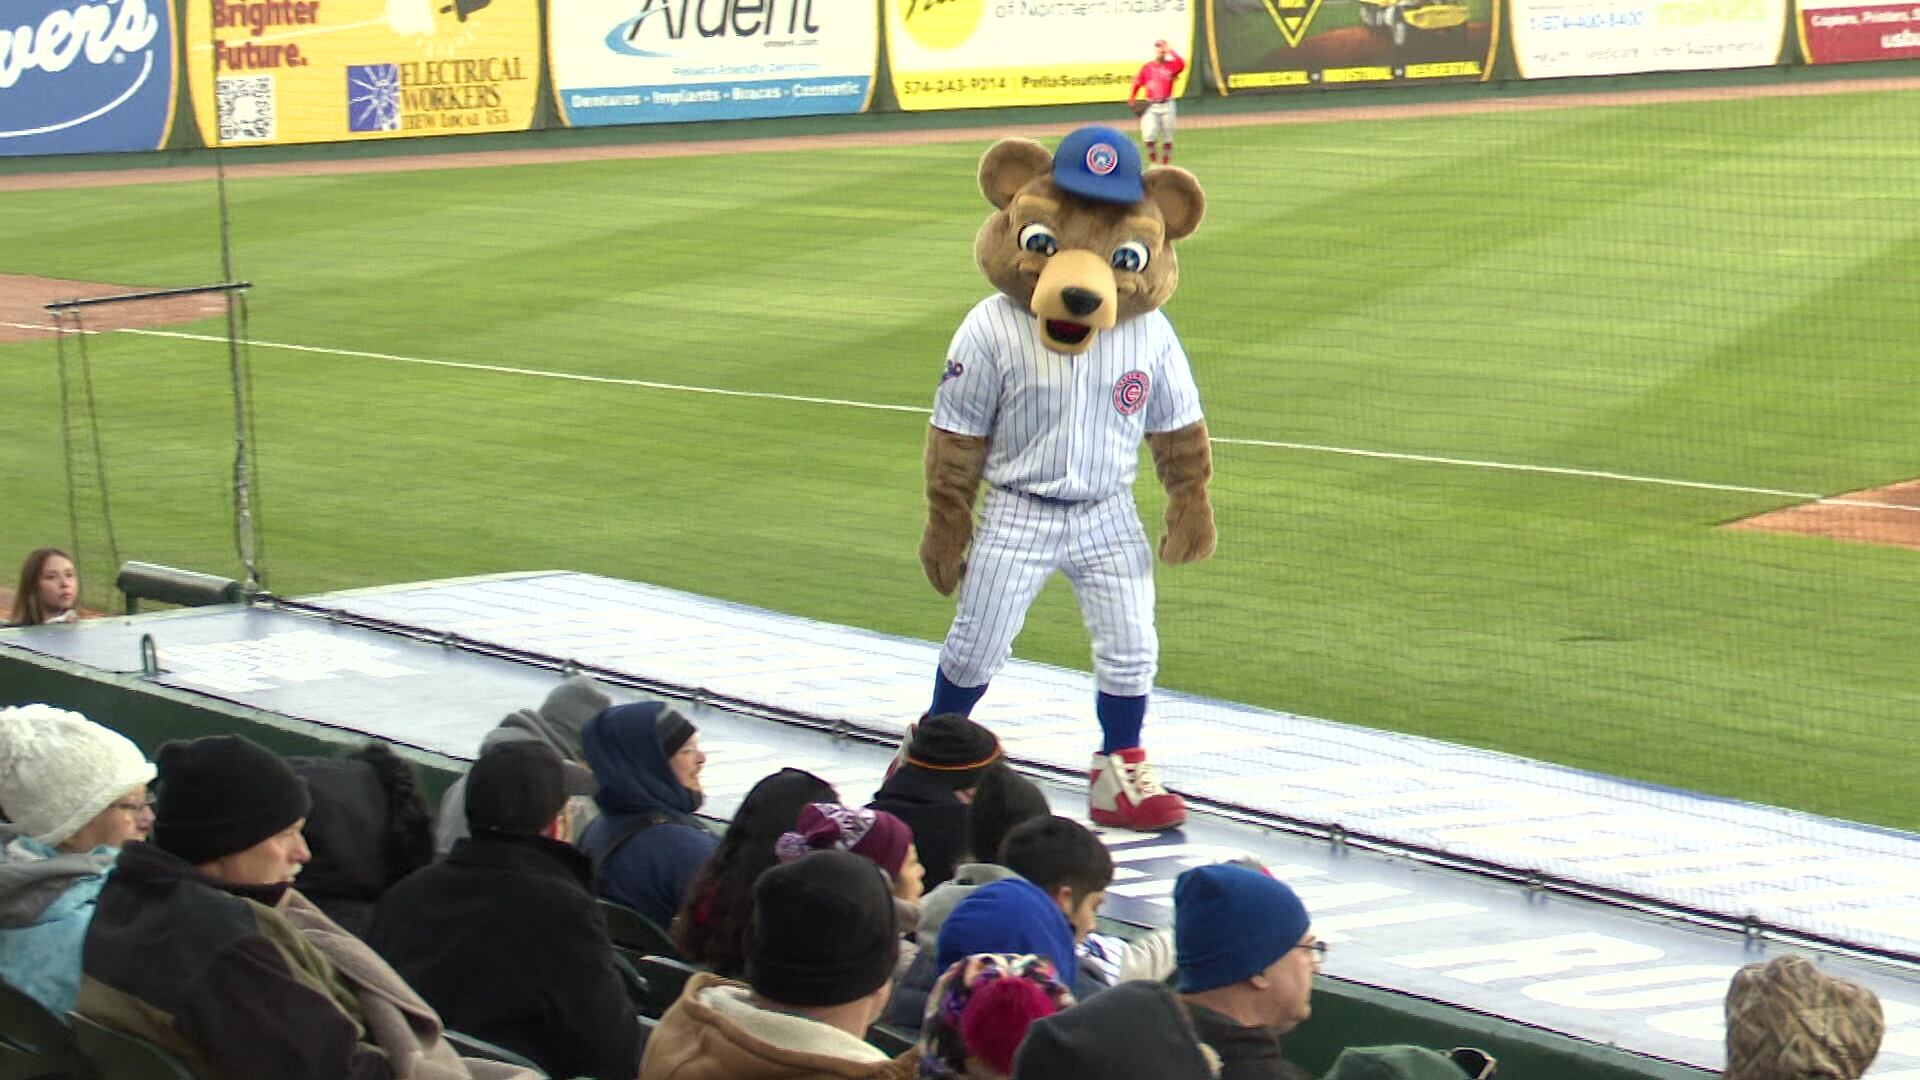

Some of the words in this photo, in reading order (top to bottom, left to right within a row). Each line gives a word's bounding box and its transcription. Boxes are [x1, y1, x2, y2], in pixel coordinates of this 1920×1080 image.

[213, 0, 320, 36] Brighter
[214, 39, 308, 73] Future.
[400, 57, 528, 86] ELECTRICAL
[1022, 73, 1138, 89] PellaSouthBen
[401, 83, 501, 111] WORKERS
